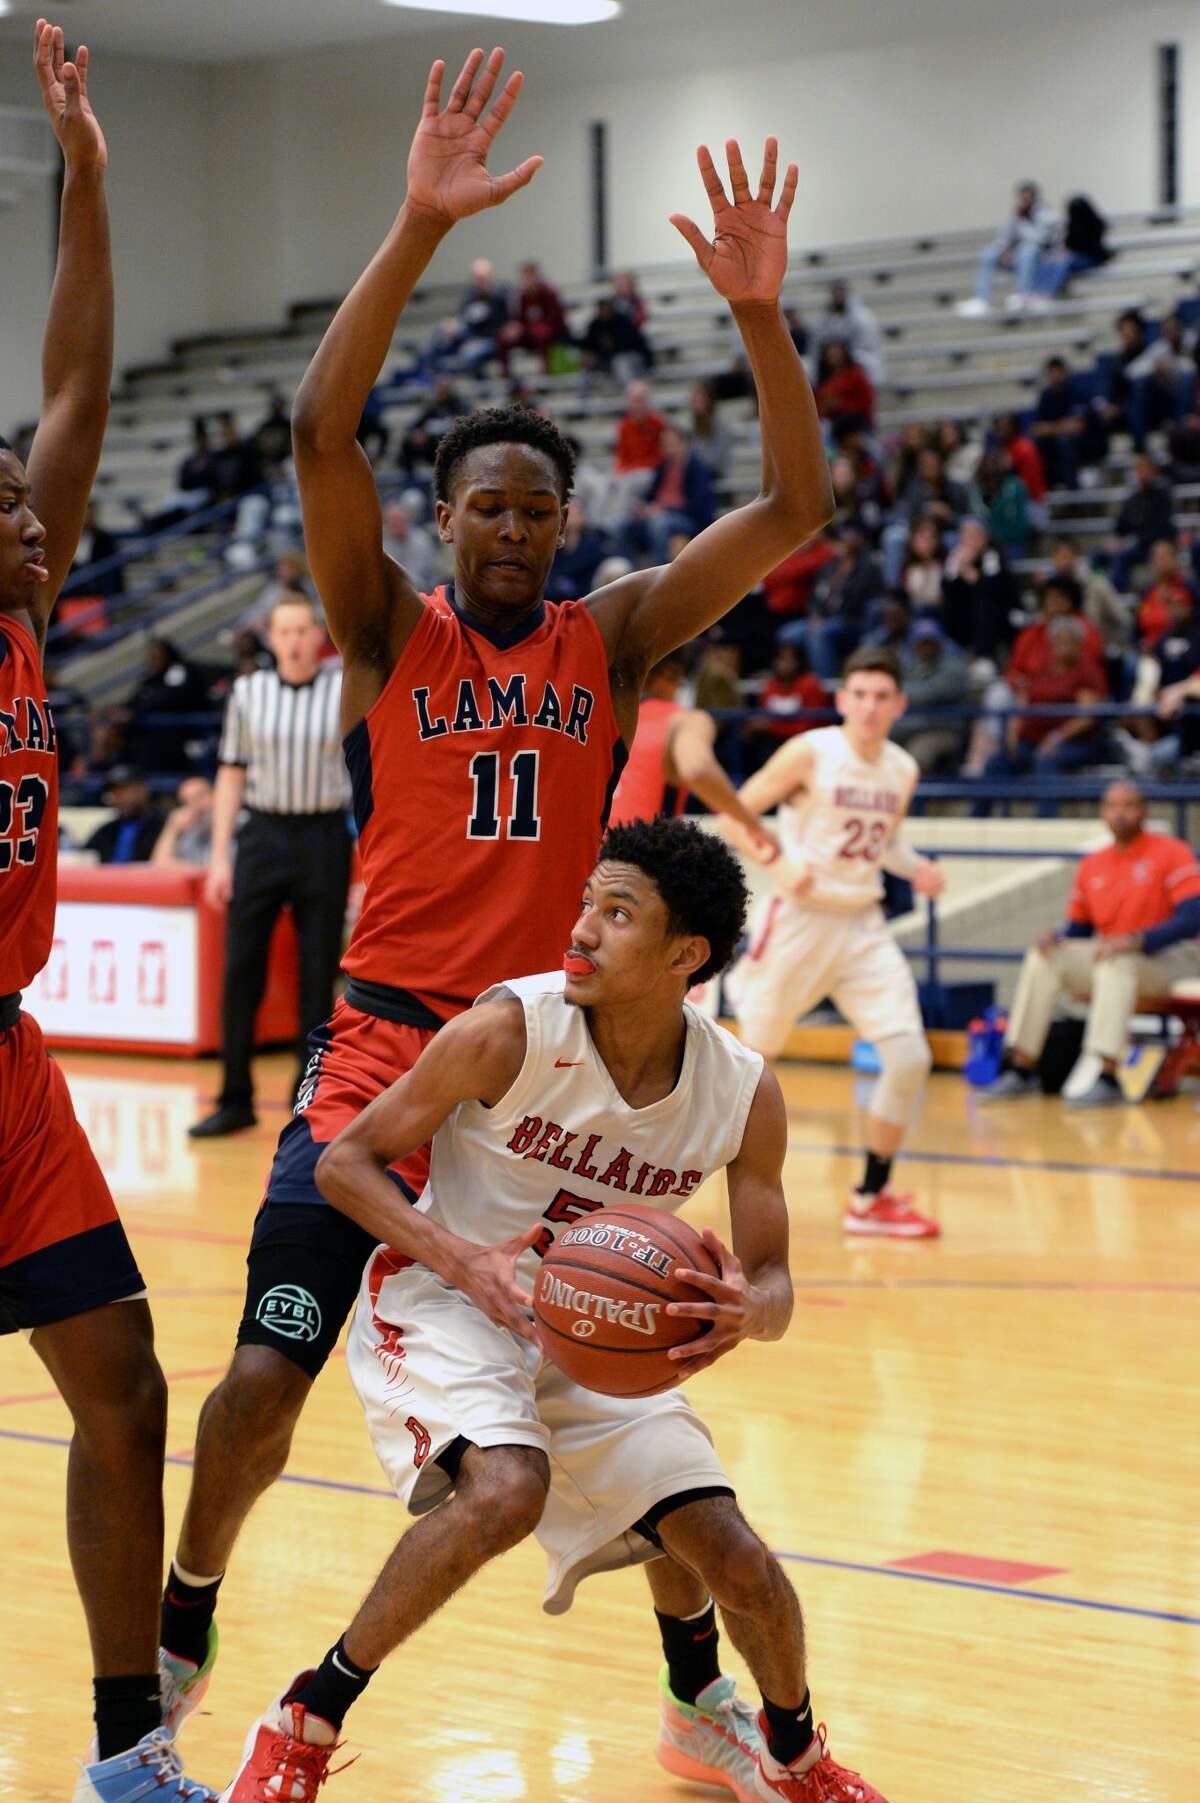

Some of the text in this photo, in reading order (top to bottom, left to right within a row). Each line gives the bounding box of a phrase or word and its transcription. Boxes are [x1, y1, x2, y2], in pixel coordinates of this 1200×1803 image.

[412, 674, 595, 746] LAMAR
[466, 750, 541, 841] 11
[507, 1115, 703, 1197] BELLAIRE
[561, 1227, 673, 1280] TF-1000
[265, 1299, 316, 1326] EYBL
[540, 1271, 661, 1335] SPALDING
